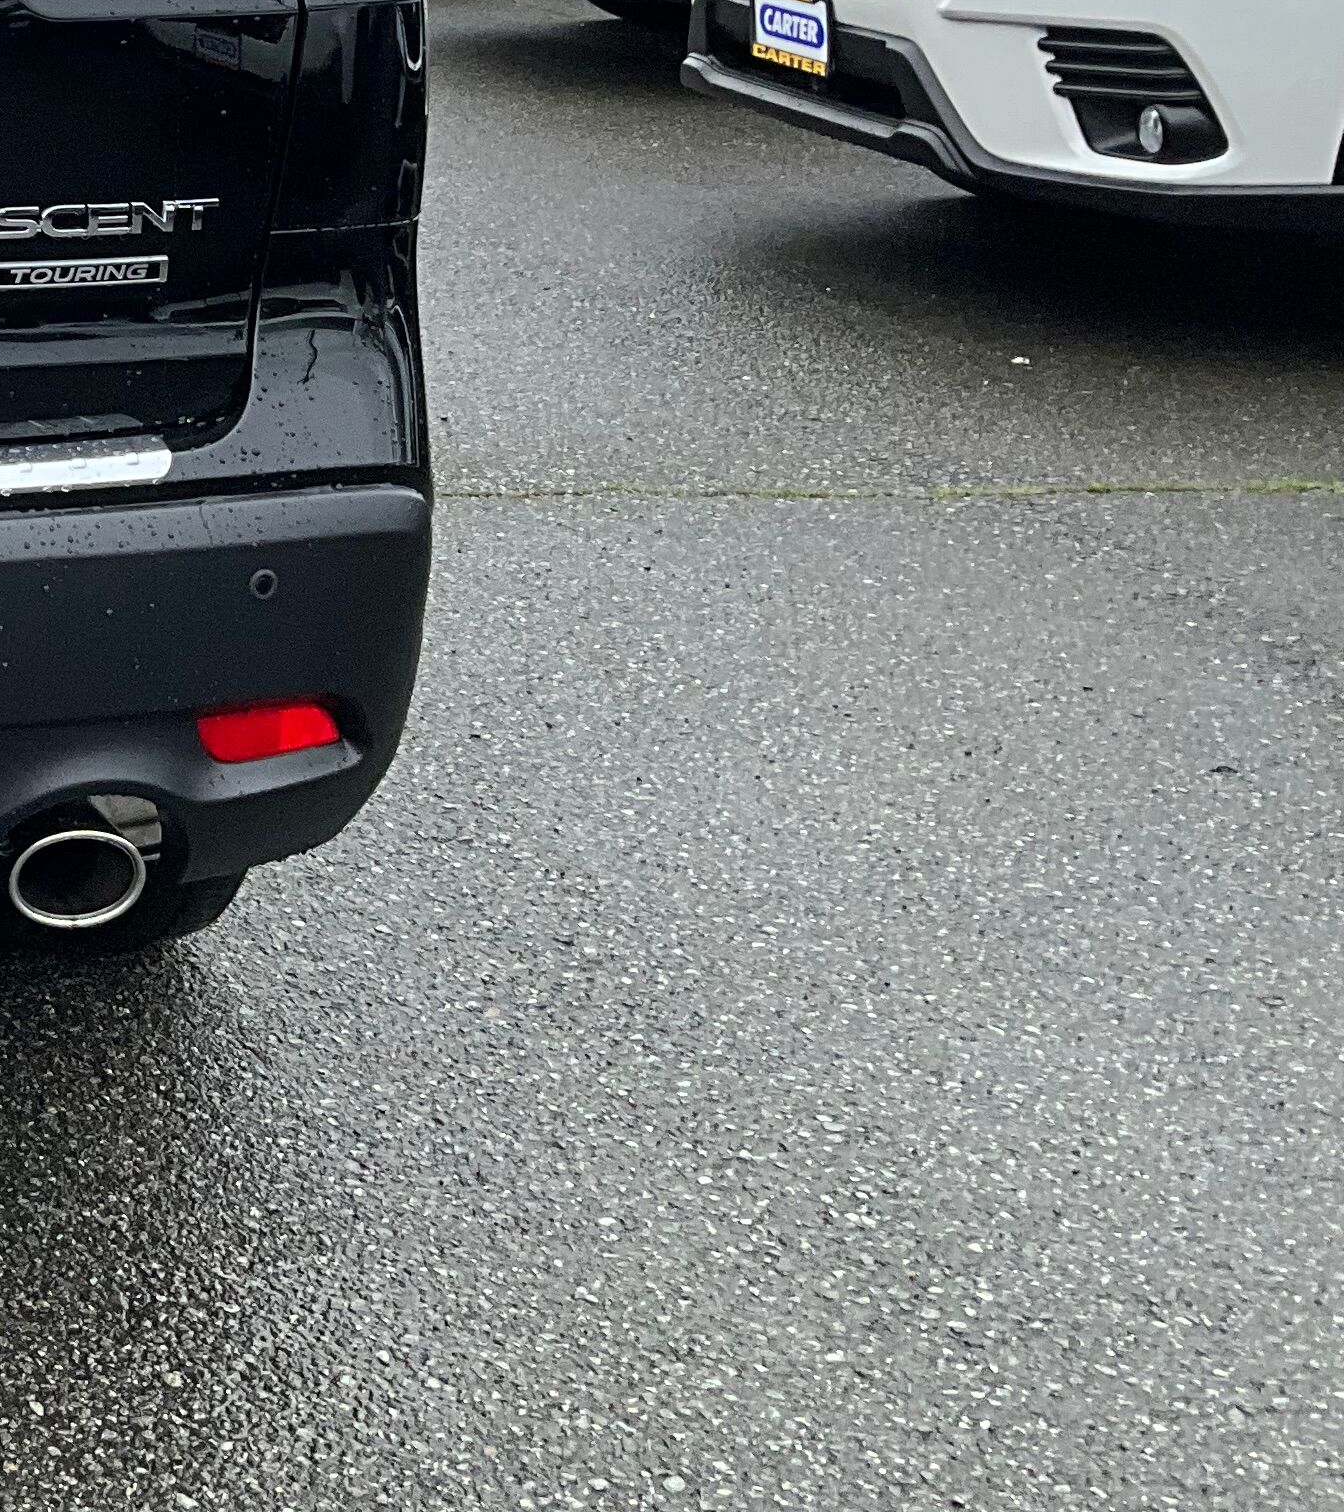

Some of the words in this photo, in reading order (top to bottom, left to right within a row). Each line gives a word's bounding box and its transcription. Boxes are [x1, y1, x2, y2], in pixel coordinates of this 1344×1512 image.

[763, 8, 819, 45] CARTER
[752, 42, 827, 78] CARTER
[10, 264, 150, 285] TOURING
